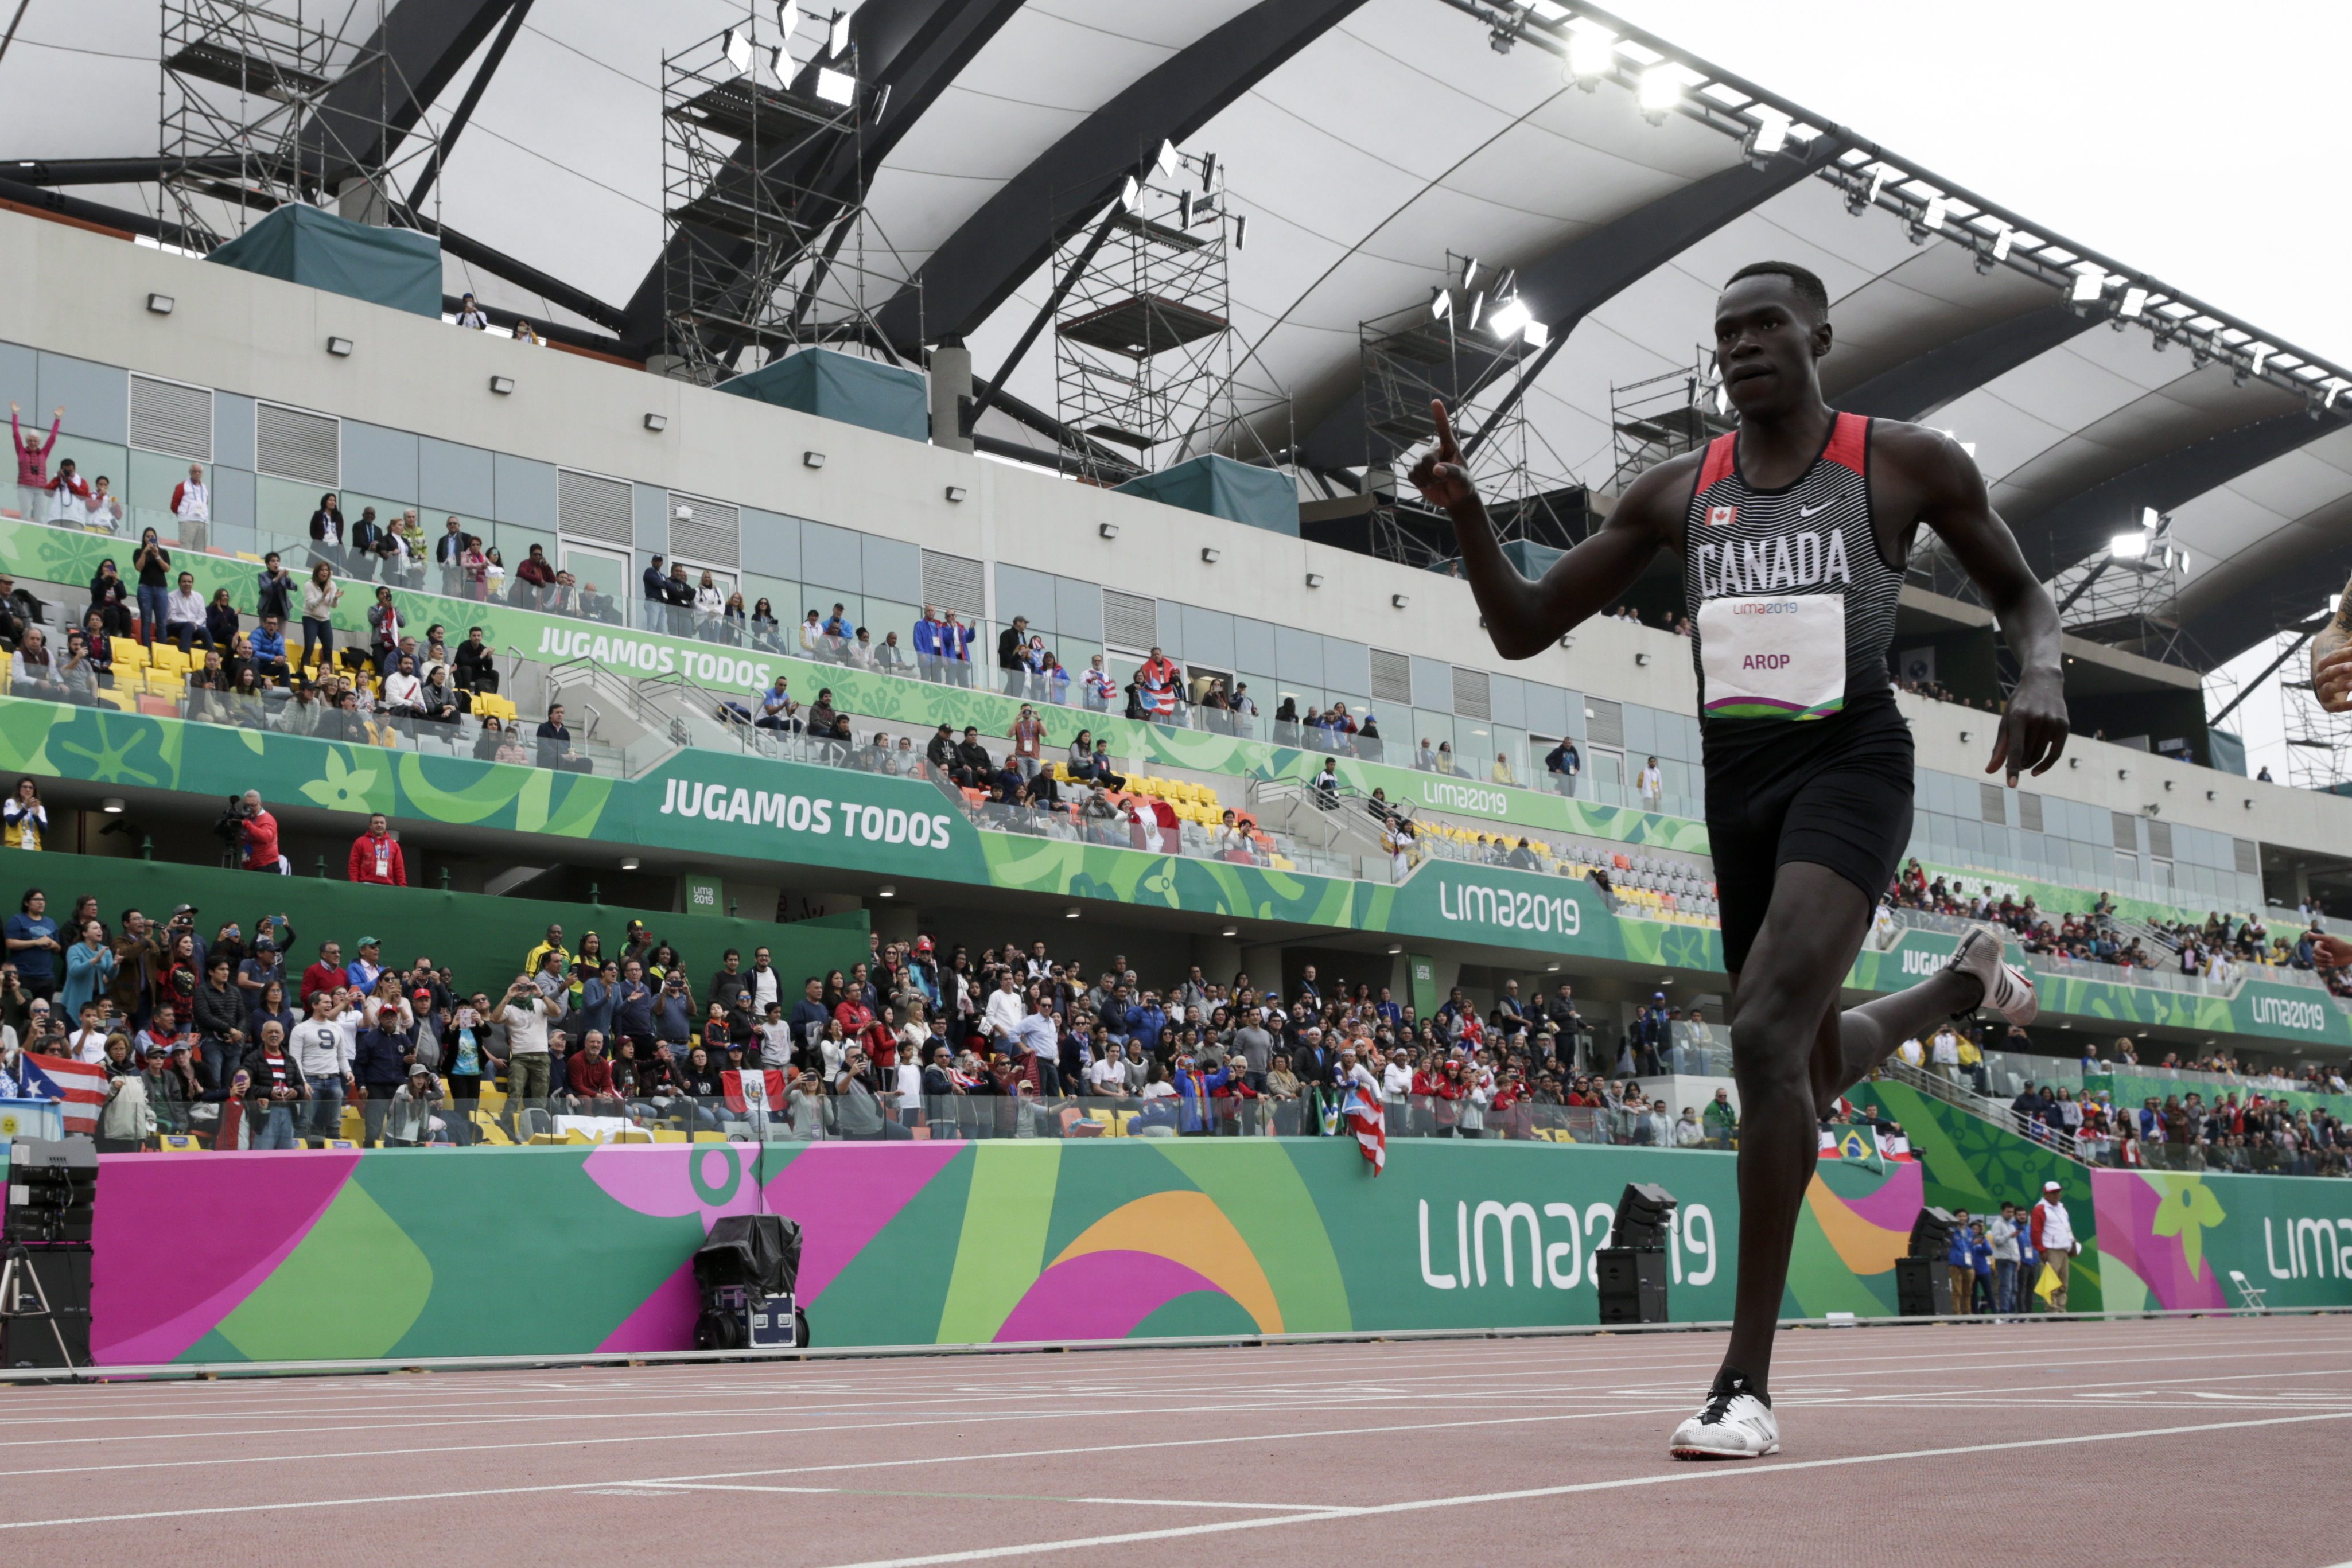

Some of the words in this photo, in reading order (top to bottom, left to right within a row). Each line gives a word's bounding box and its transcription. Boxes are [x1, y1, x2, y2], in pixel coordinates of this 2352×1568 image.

[1698, 529, 1851, 596] CANADA
[538, 627, 678, 673] JUGAMOS
[682, 651, 771, 690] TODOS
[1743, 654, 1790, 670] AROP
[660, 778, 832, 834] JUGAMOS
[840, 802, 951, 849] TODOS
[694, 894, 714, 905] 2019
[318, 1029, 335, 1049] 9
[1418, 1198, 1717, 1290] Lima219
